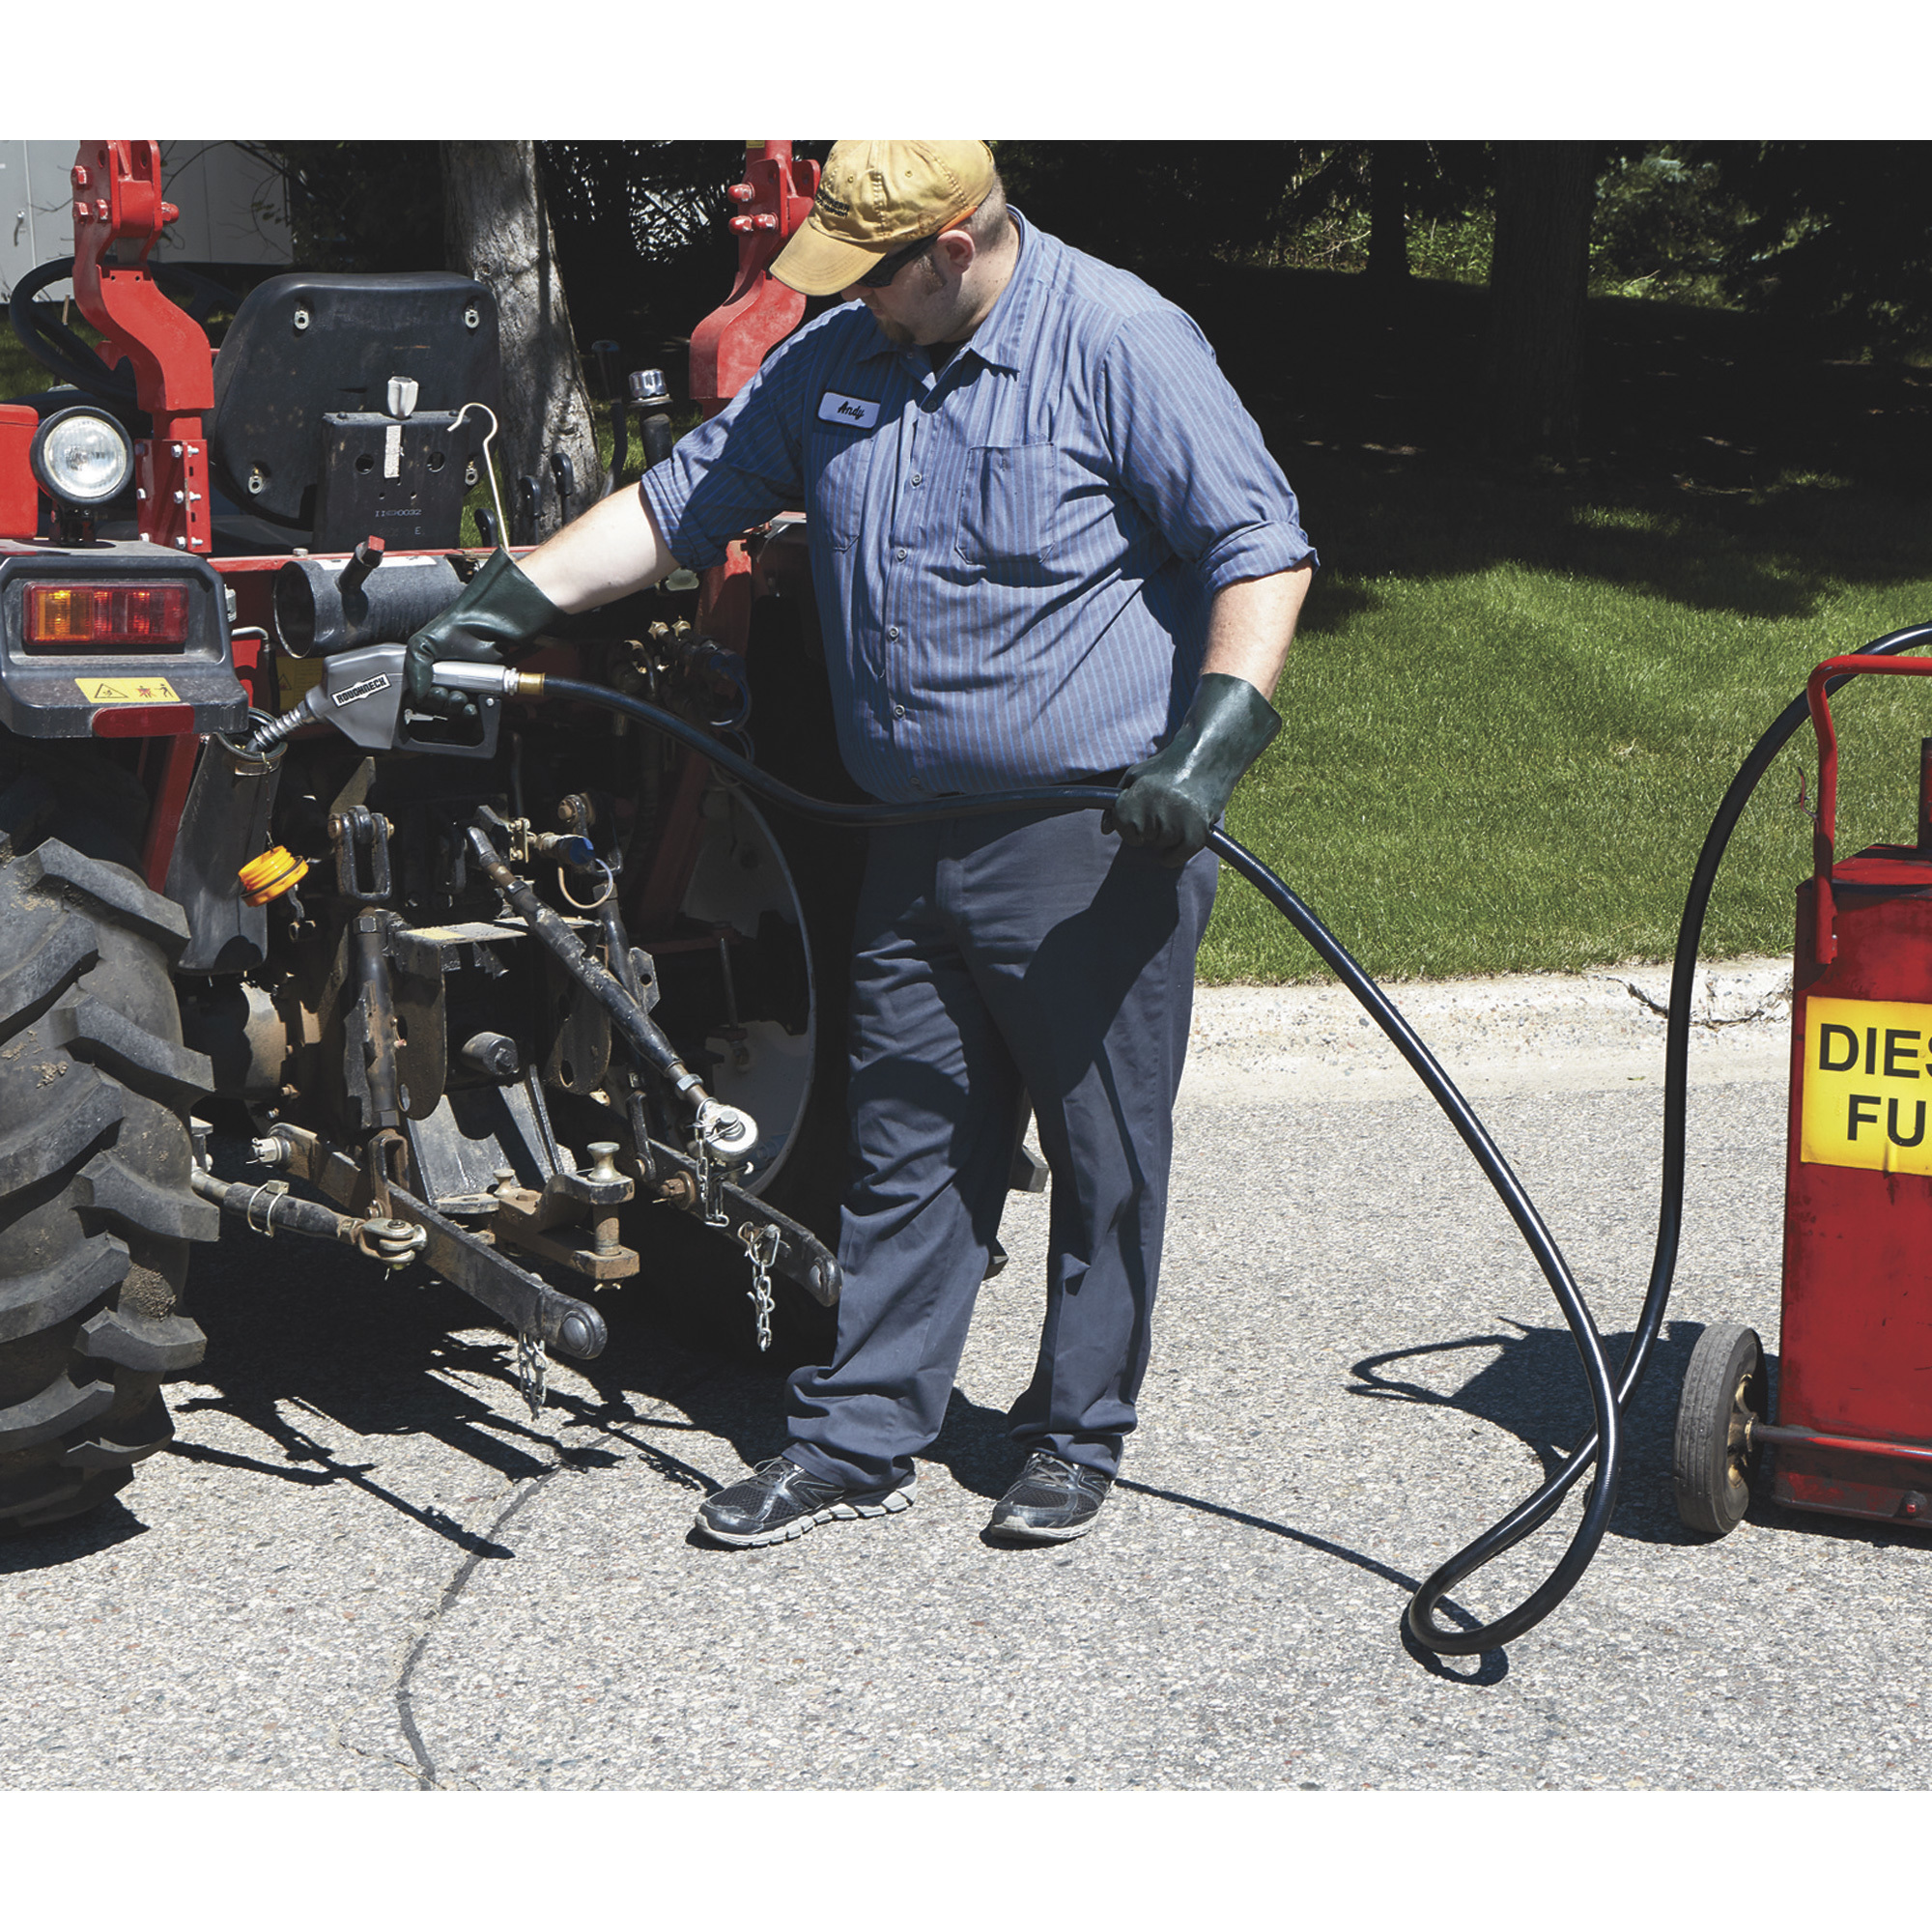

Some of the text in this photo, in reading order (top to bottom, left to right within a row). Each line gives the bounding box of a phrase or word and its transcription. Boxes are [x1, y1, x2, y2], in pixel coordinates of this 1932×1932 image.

[837, 400, 866, 421] Andy
[335, 676, 387, 704] ROUGHNECK
[1819, 1022, 1932, 1079] DIE
[1847, 1094, 1926, 1148] FU
